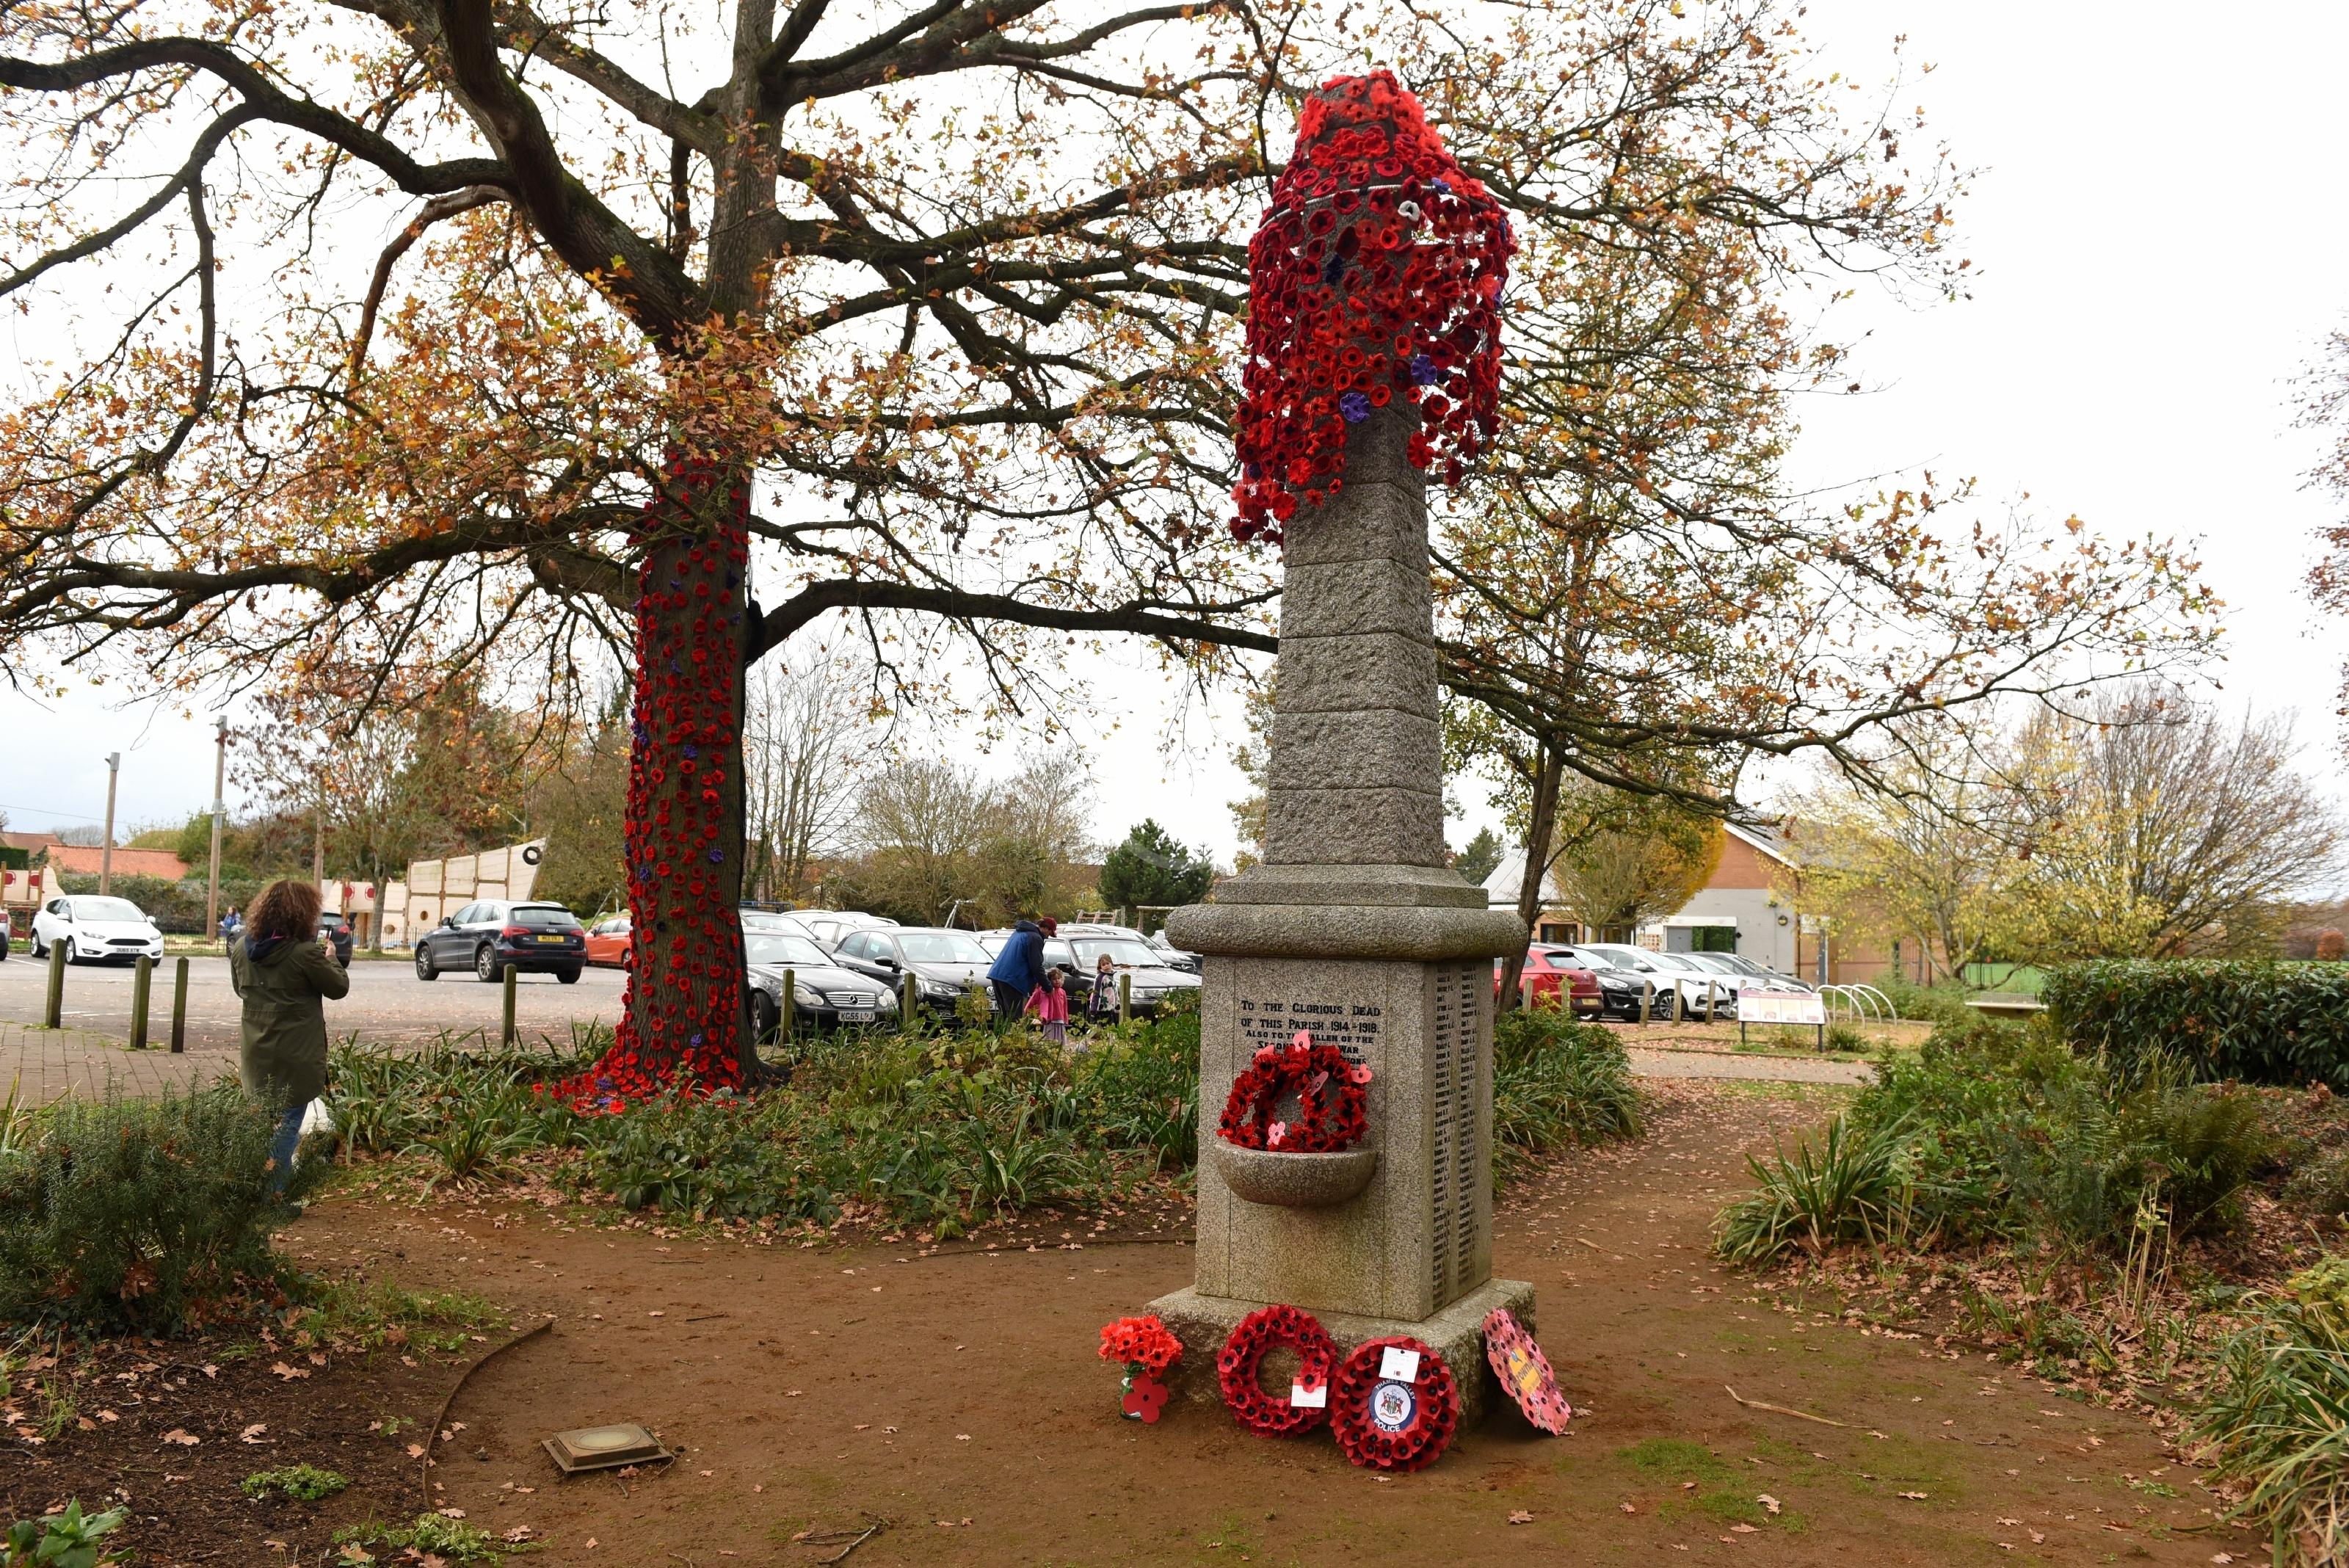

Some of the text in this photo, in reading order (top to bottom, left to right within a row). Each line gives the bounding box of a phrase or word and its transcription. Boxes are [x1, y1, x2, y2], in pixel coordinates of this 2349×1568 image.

[1241, 1001, 1381, 1017] TO THE GLORIOUS DEAD
[1241, 1018, 1253, 1027] OF
[1260, 1019, 1282, 1028] THIS
[1288, 1019, 1324, 1031] PARISH
[1246, 1030, 1268, 1038] ALSO
[1338, 1045, 1359, 1054] WAR
[1375, 1379, 1416, 1400] THAMES VALLEY
[1374, 1418, 1401, 1432] POLICE
